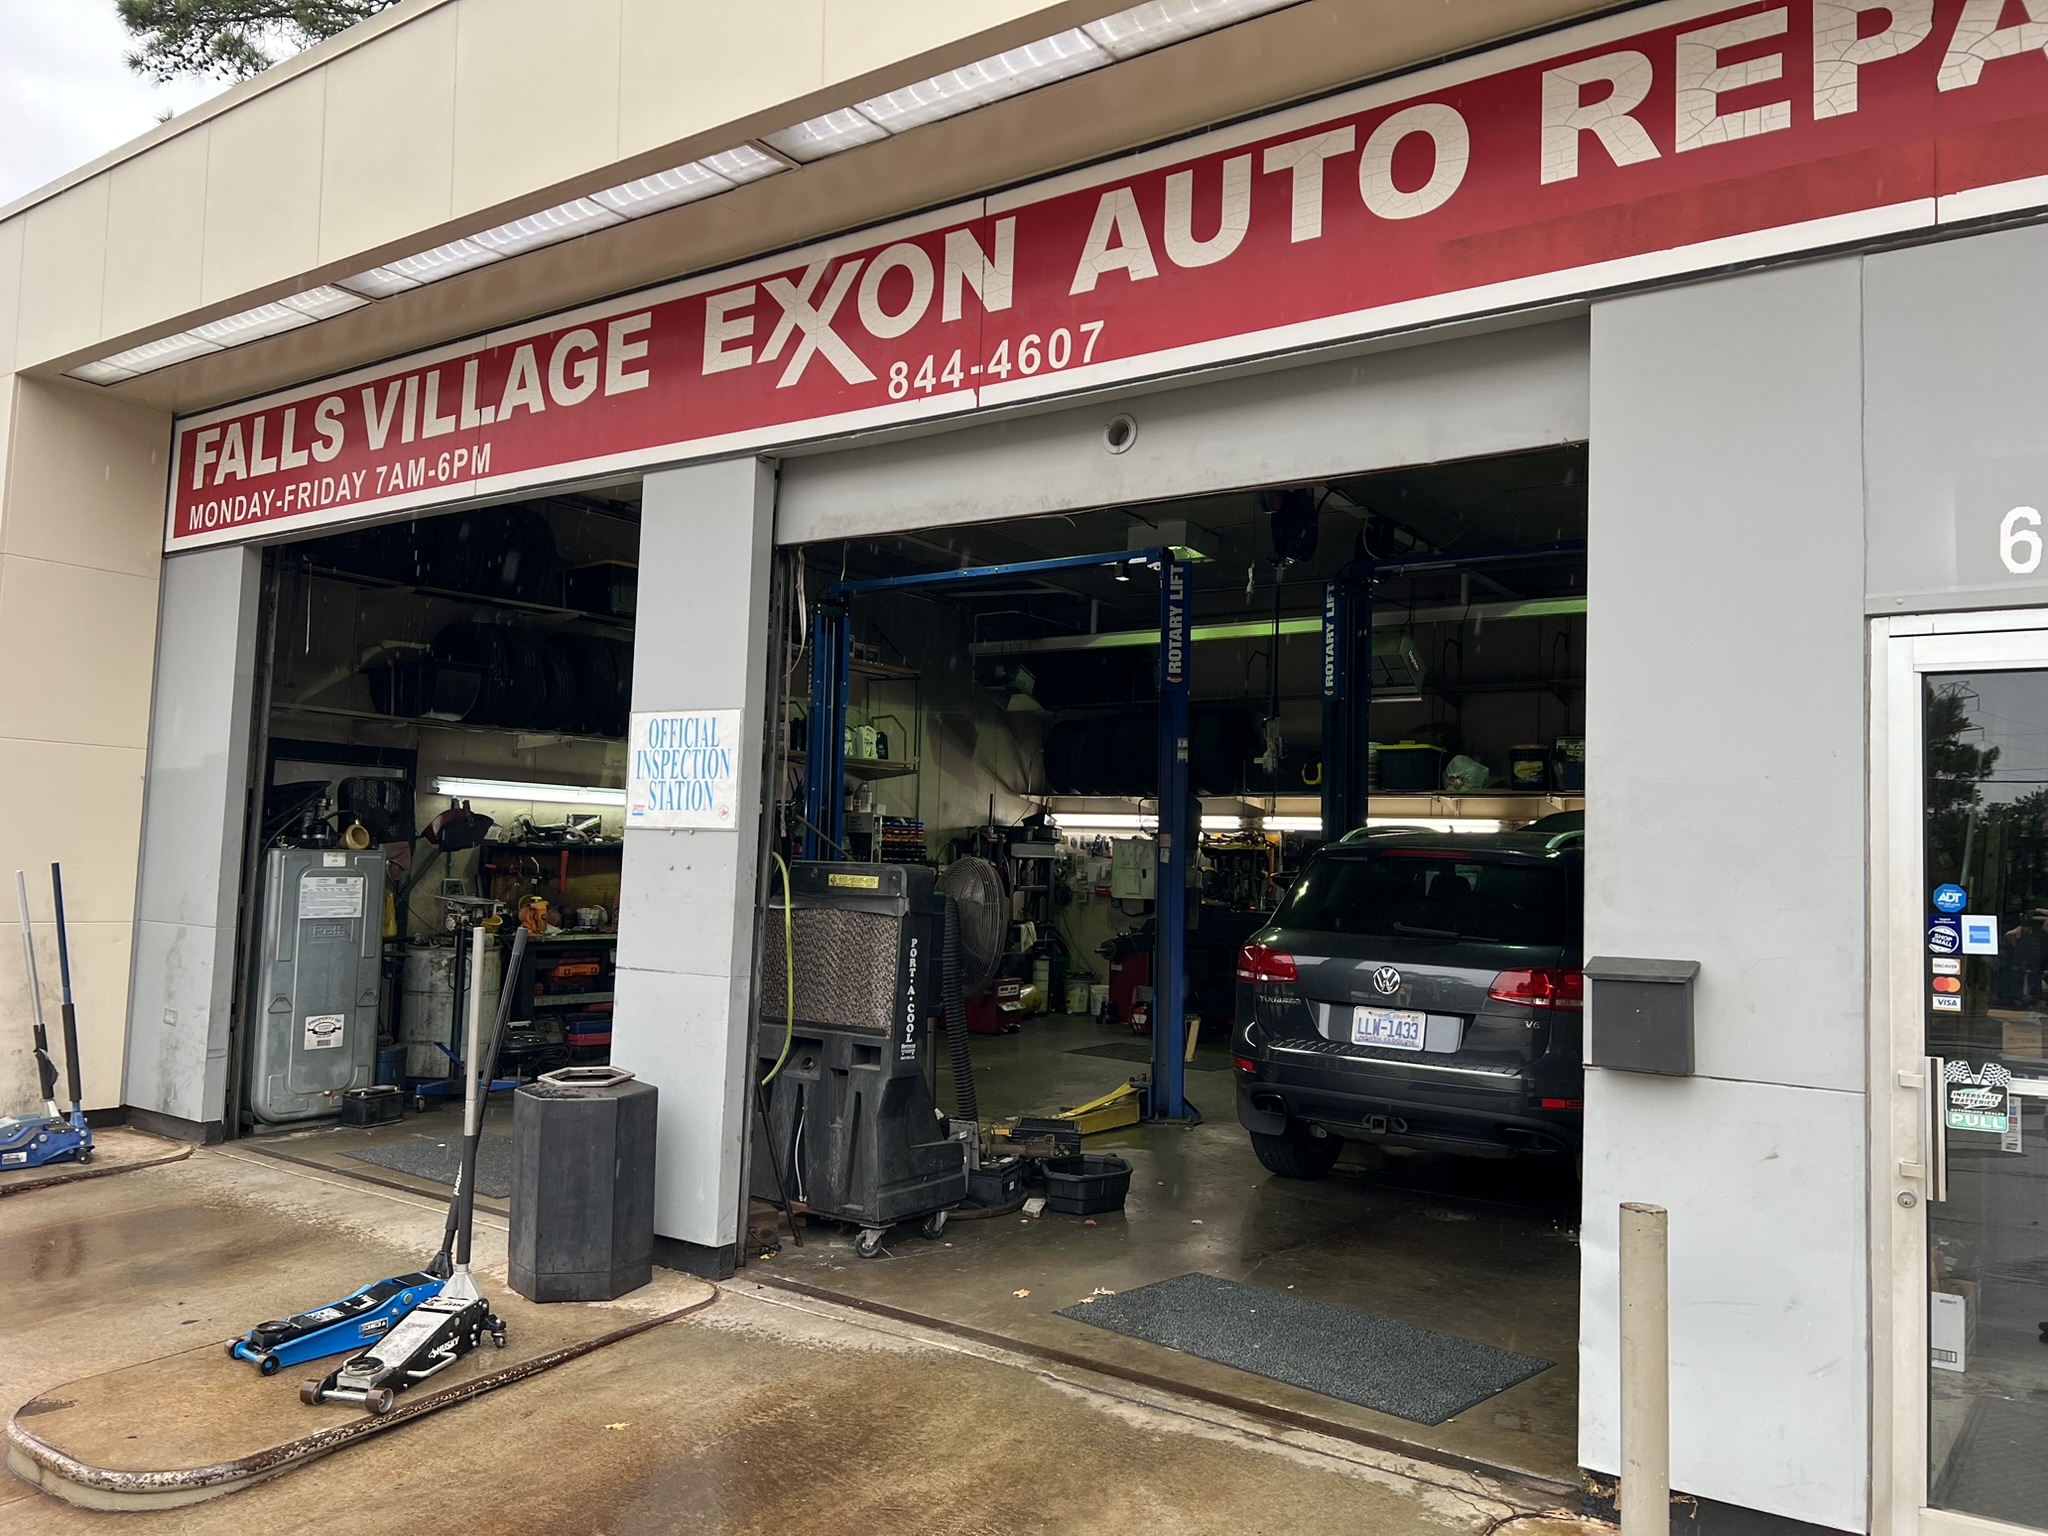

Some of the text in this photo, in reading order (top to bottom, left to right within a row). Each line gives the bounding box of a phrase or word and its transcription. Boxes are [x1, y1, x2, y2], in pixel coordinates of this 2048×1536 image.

[192, 396, 345, 490] FALLS
[361, 311, 652, 451] VILLAGE
[702, 216, 1017, 389] EXXON
[1069, 103, 1470, 296] AUTO
[887, 320, 1105, 400] 844-4607
[188, 442, 492, 530] MONDAY-FRIDAY 7AM-6PM
[2000, 505, 2043, 574] 6
[1169, 564, 1184, 600] LIFT
[1168, 605, 1183, 674] ROTARY
[1325, 583, 1335, 687] ROTARY LIFT
[648, 717, 720, 749] OFFICIAL
[636, 748, 731, 780] INSPECTION
[648, 780, 714, 811] STATION
[1937, 892, 1963, 903] ADT
[1931, 937, 1953, 948] SMALL
[1934, 933, 1953, 942] SHOP
[1525, 1020, 1540, 1029] V6
[1383, 1037, 1416, 1046] CAROLINA
[1953, 1091, 2000, 1100] INTERSTATE
[1954, 1098, 1997, 1106] BATTERIES
[1951, 1113, 2005, 1129] PULL
[436, 1336, 460, 1354] HUSKY
